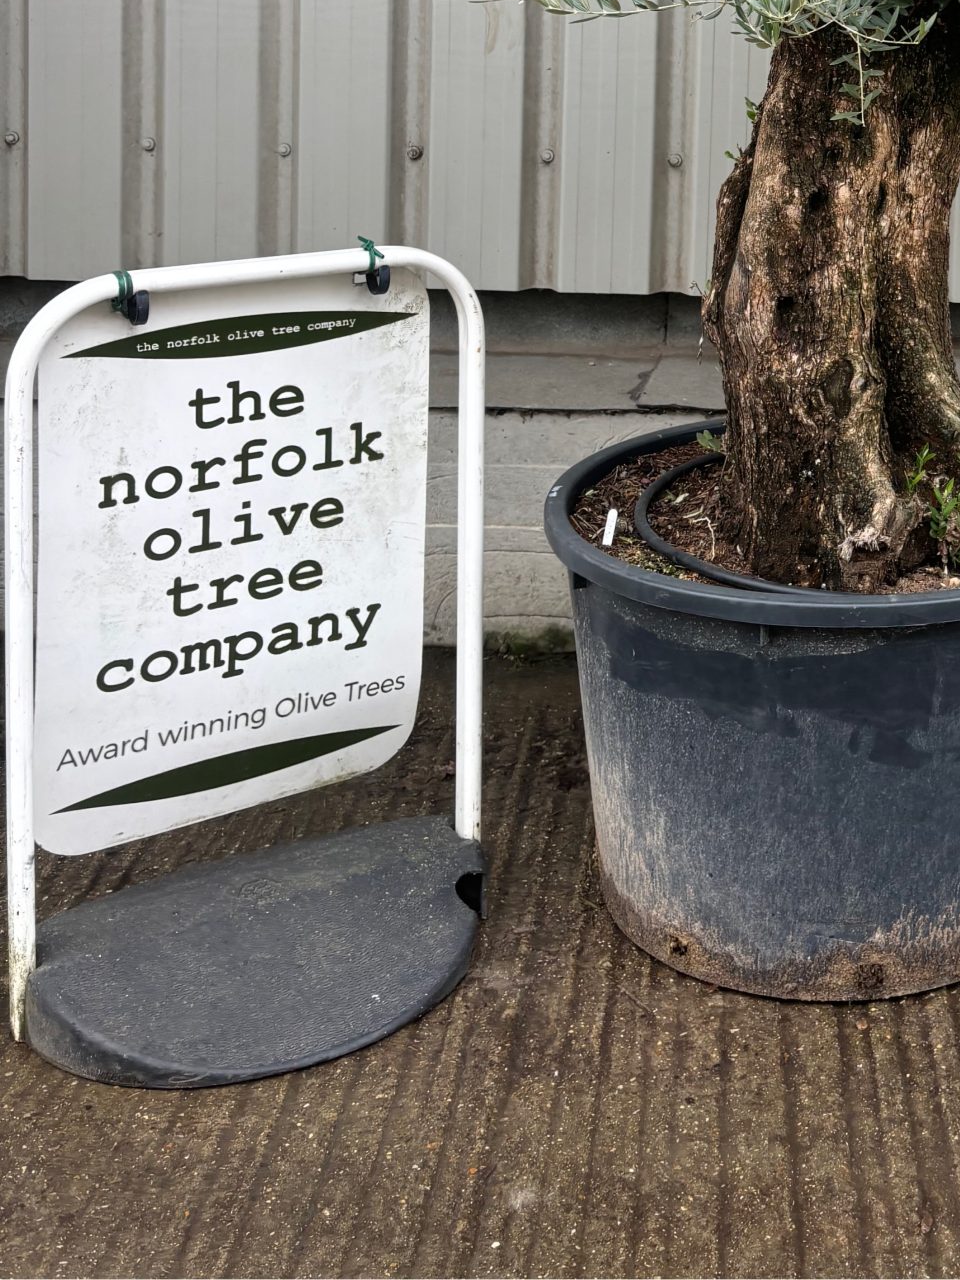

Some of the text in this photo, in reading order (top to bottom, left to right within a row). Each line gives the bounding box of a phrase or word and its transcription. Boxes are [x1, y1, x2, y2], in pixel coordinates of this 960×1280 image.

[136, 317, 357, 353] the norfolk olive tree company
[188, 380, 305, 430] the
[98, 422, 385, 509] norfolk
[143, 497, 345, 562] olive
[166, 559, 323, 617] tree
[96, 603, 382, 694] company
[56, 674, 406, 772] Award winning Olive Trees
